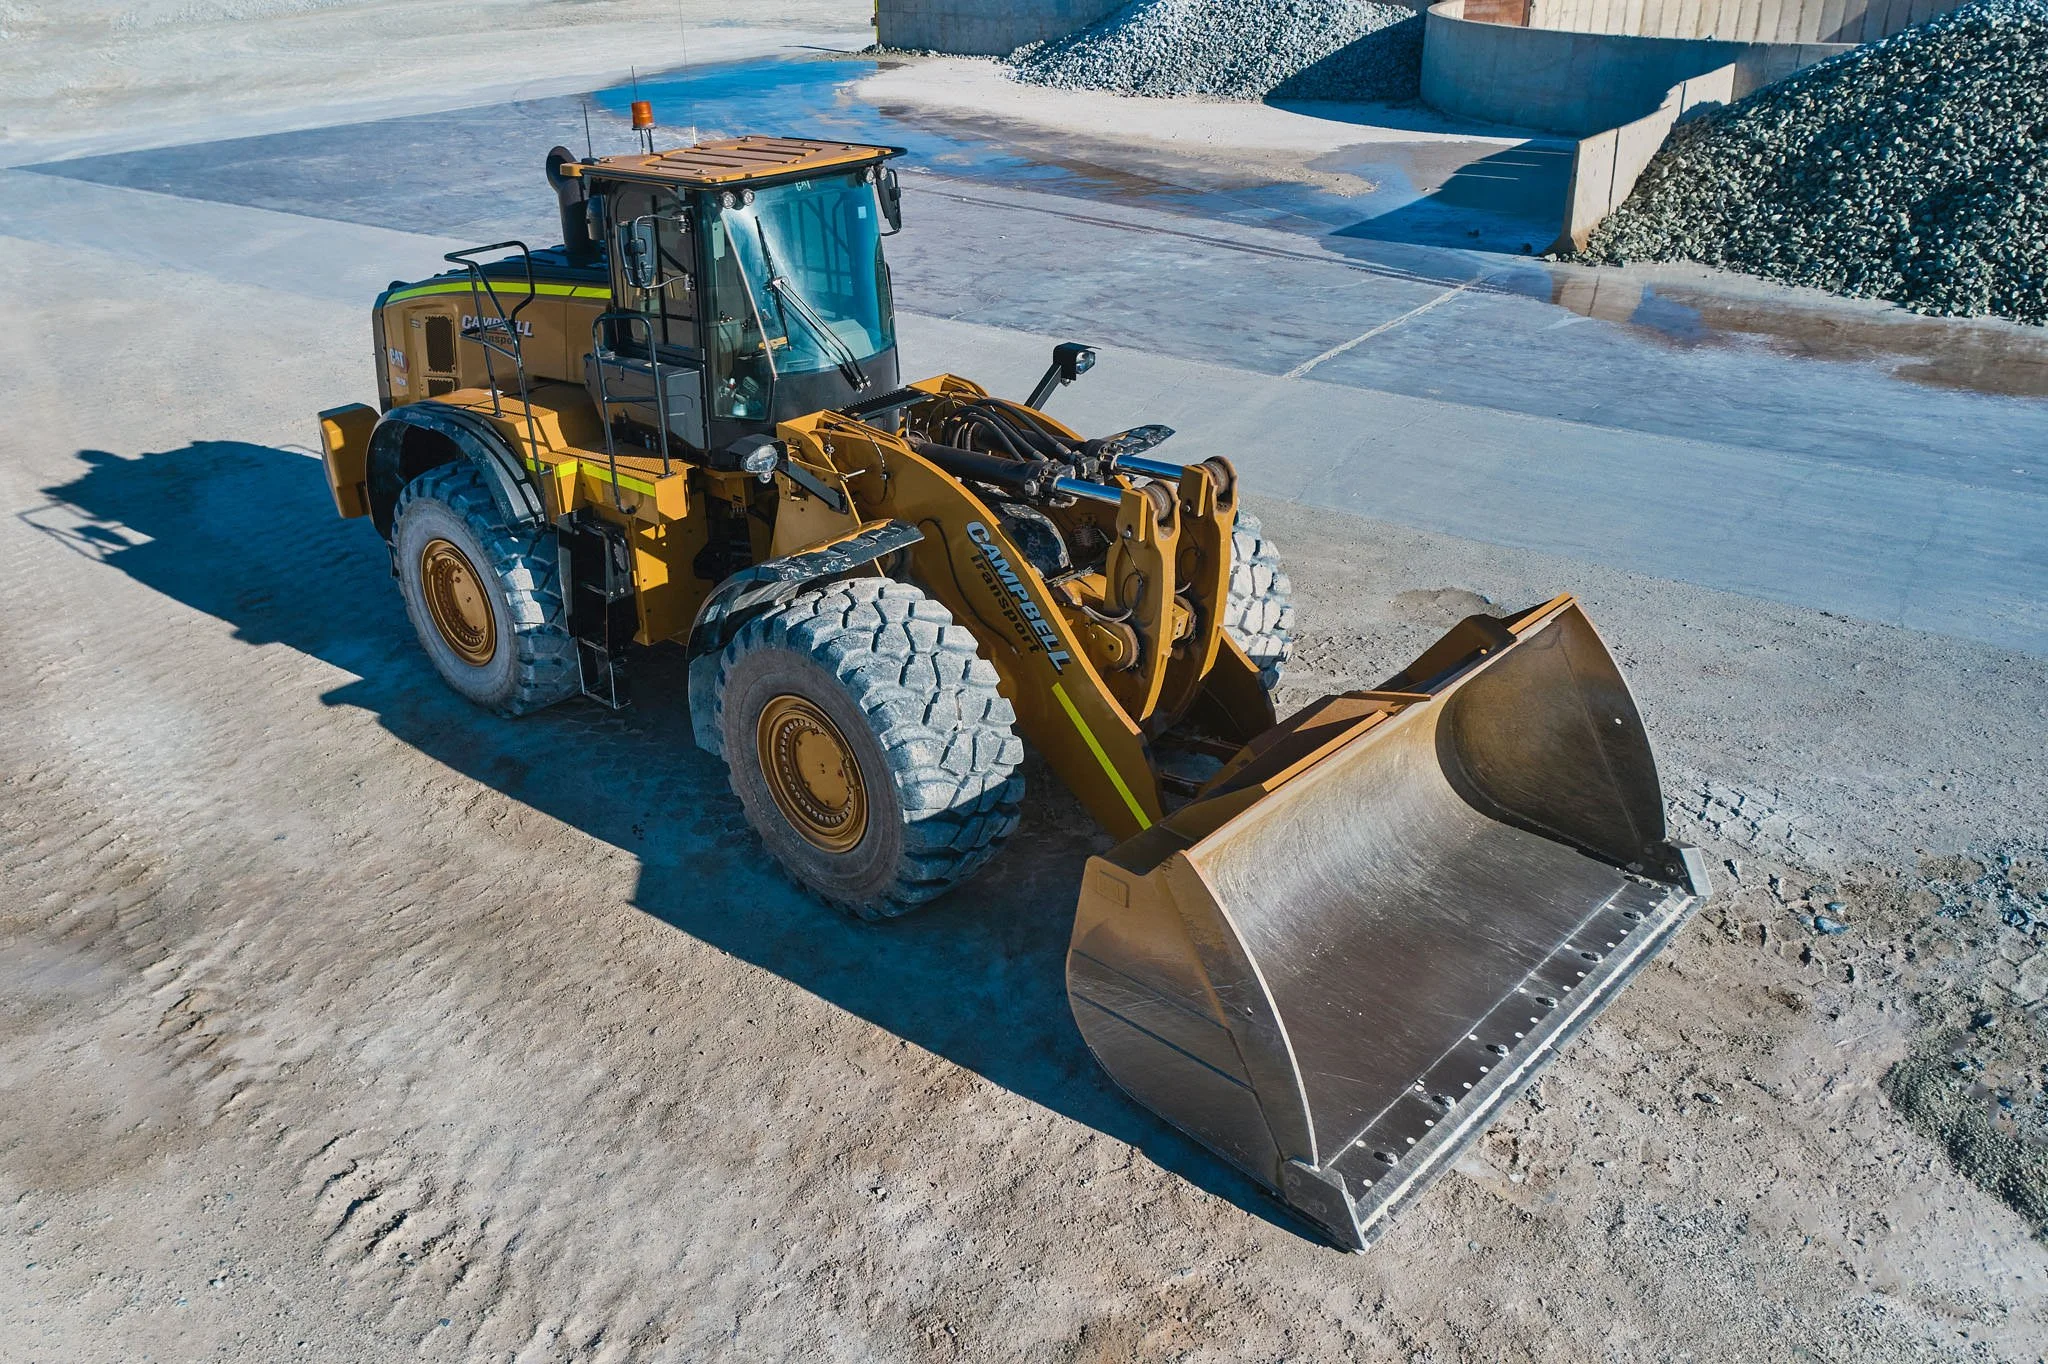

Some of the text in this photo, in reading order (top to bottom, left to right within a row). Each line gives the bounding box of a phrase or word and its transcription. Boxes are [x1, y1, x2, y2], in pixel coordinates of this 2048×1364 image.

[795, 180, 811, 192] CAT
[462, 315, 533, 337] CAMPLL
[389, 347, 406, 369] CAT
[966, 521, 1071, 674] CAMPBELL
[970, 550, 1042, 654] Transport
